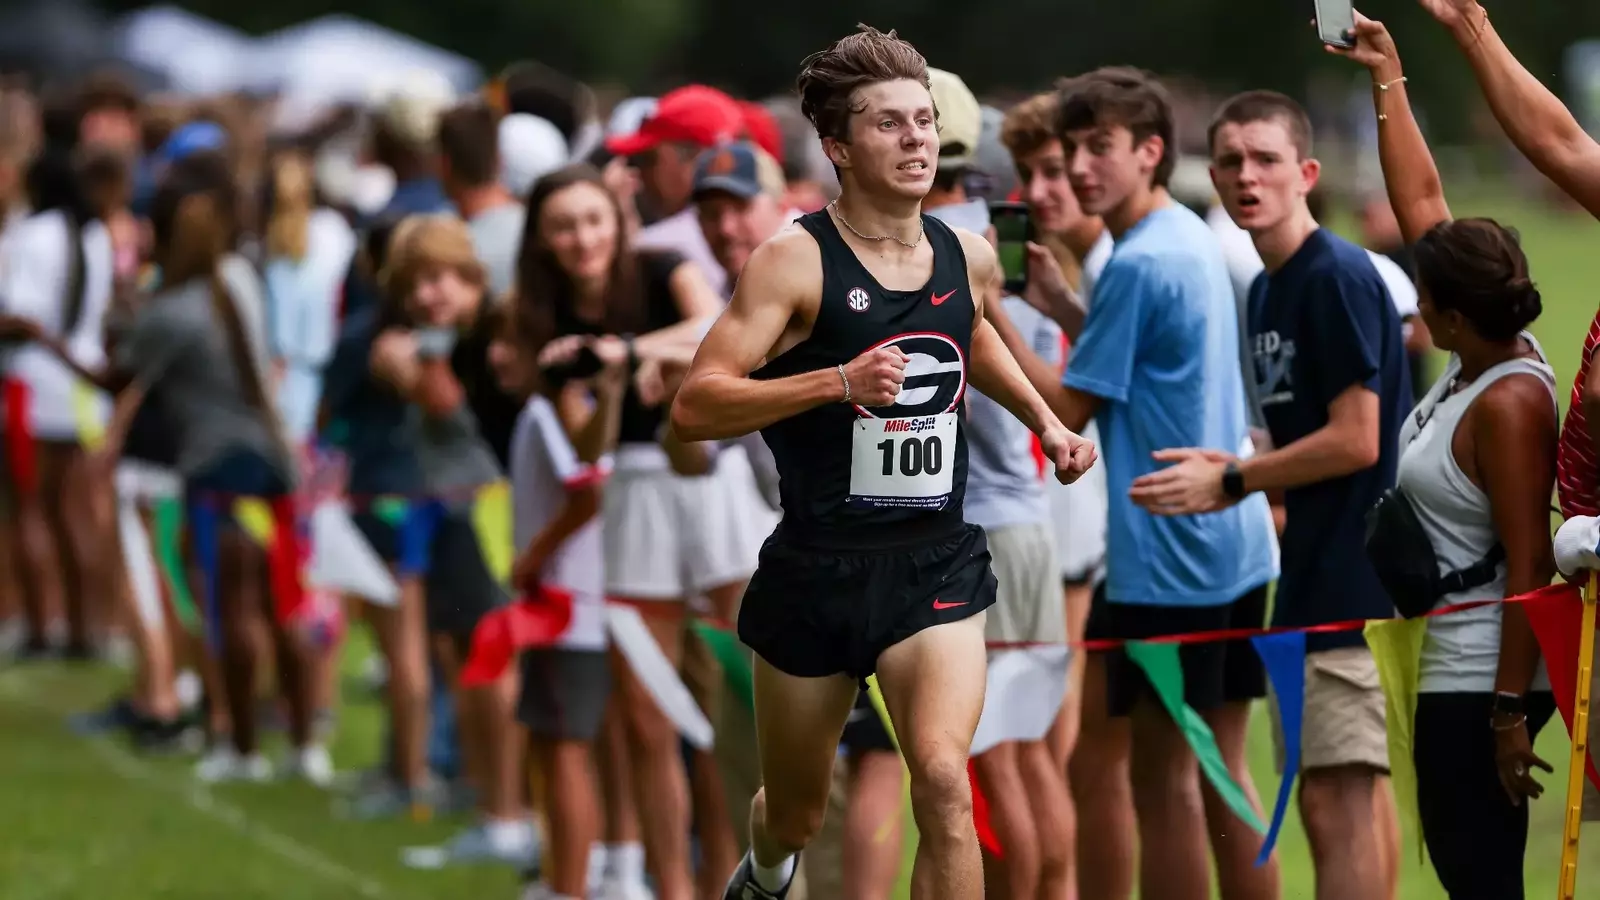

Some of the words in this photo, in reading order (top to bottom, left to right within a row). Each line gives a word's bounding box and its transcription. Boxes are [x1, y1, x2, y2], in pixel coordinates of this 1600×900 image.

[848, 288, 869, 310] SEC
[884, 417, 936, 433] MileSplit
[877, 436, 942, 477] 100
